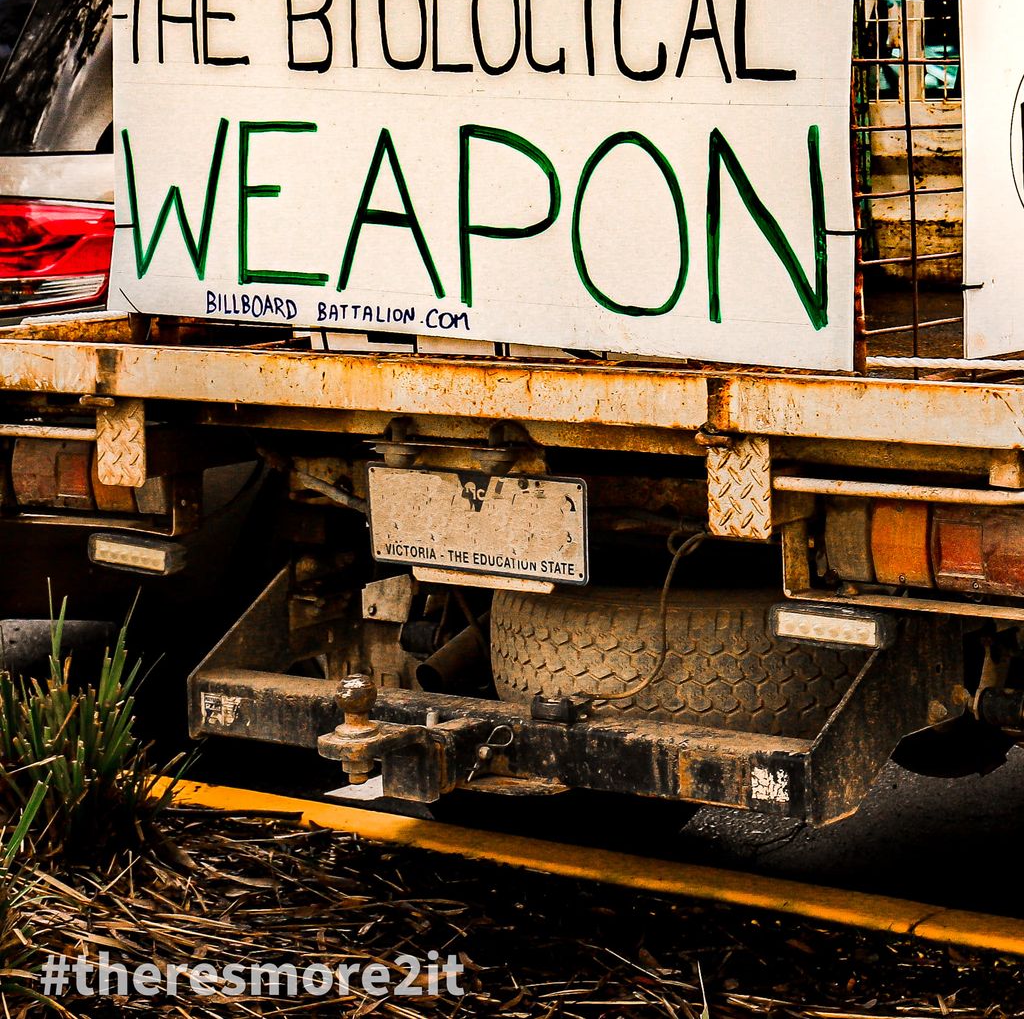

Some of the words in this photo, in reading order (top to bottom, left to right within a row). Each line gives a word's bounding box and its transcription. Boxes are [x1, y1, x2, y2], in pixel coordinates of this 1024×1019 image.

[120, 117, 829, 330] WEAPON
[206, 290, 298, 320] BILLBOARD
[385, 543, 437, 560] VICTORIA
[447, 550, 469, 564] THE
[473, 553, 537, 571] EDUCATION
[540, 560, 575, 576] STATE
